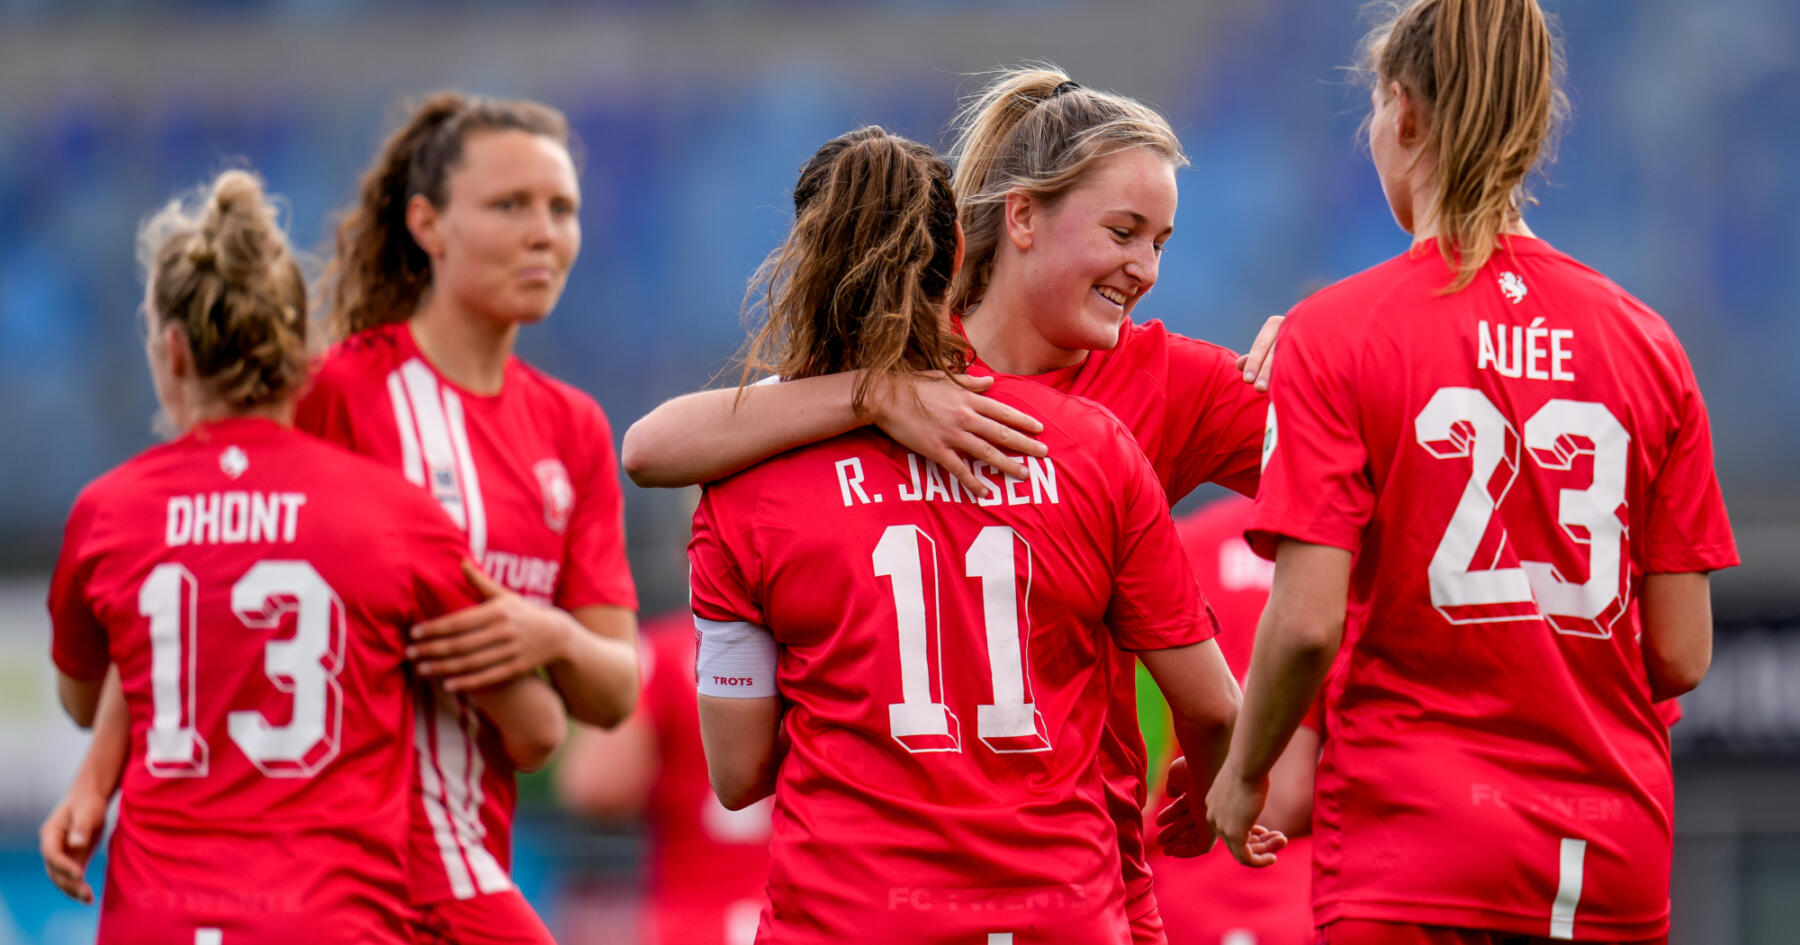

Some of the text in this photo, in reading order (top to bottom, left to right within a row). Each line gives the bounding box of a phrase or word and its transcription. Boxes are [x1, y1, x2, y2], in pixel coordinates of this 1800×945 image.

[1478, 317, 1575, 381] AUÉE
[834, 456, 883, 507] R.
[165, 490, 307, 547] DHONT
[1414, 386, 1632, 639] 23
[138, 559, 346, 778] 13
[872, 524, 1052, 754] 11
[713, 676, 753, 686] TROTS
[887, 887, 933, 912] FC
